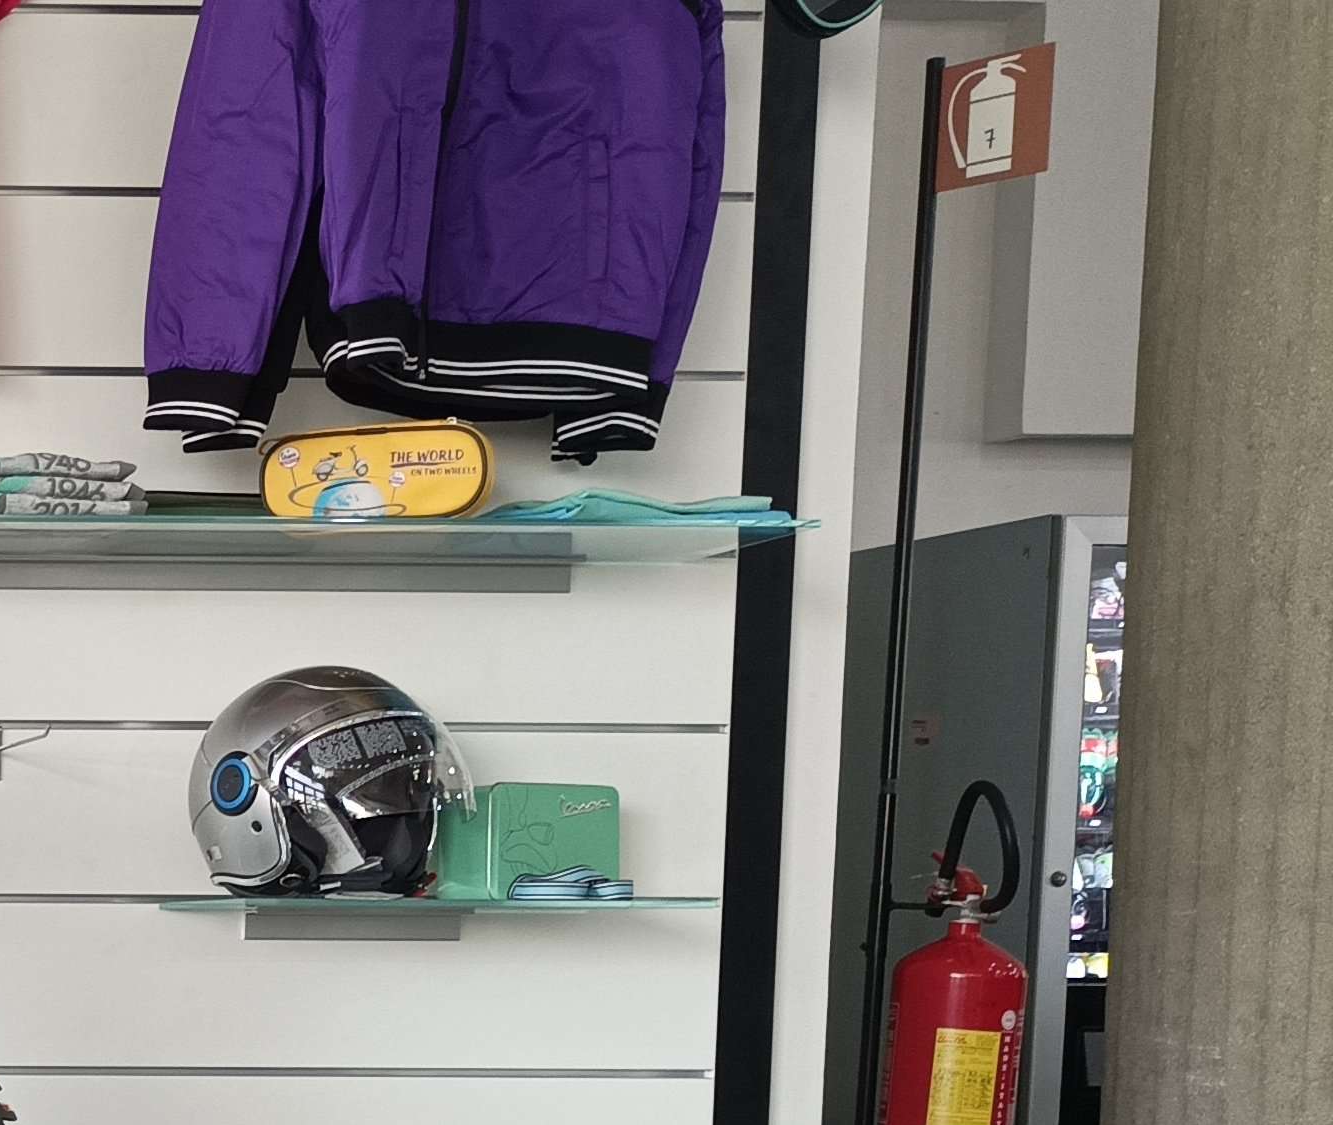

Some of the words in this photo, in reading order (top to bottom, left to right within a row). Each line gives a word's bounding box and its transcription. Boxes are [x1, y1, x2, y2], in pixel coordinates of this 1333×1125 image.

[984, 128, 996, 150] 7
[390, 450, 413, 463] THE
[417, 449, 465, 462] WORLD
